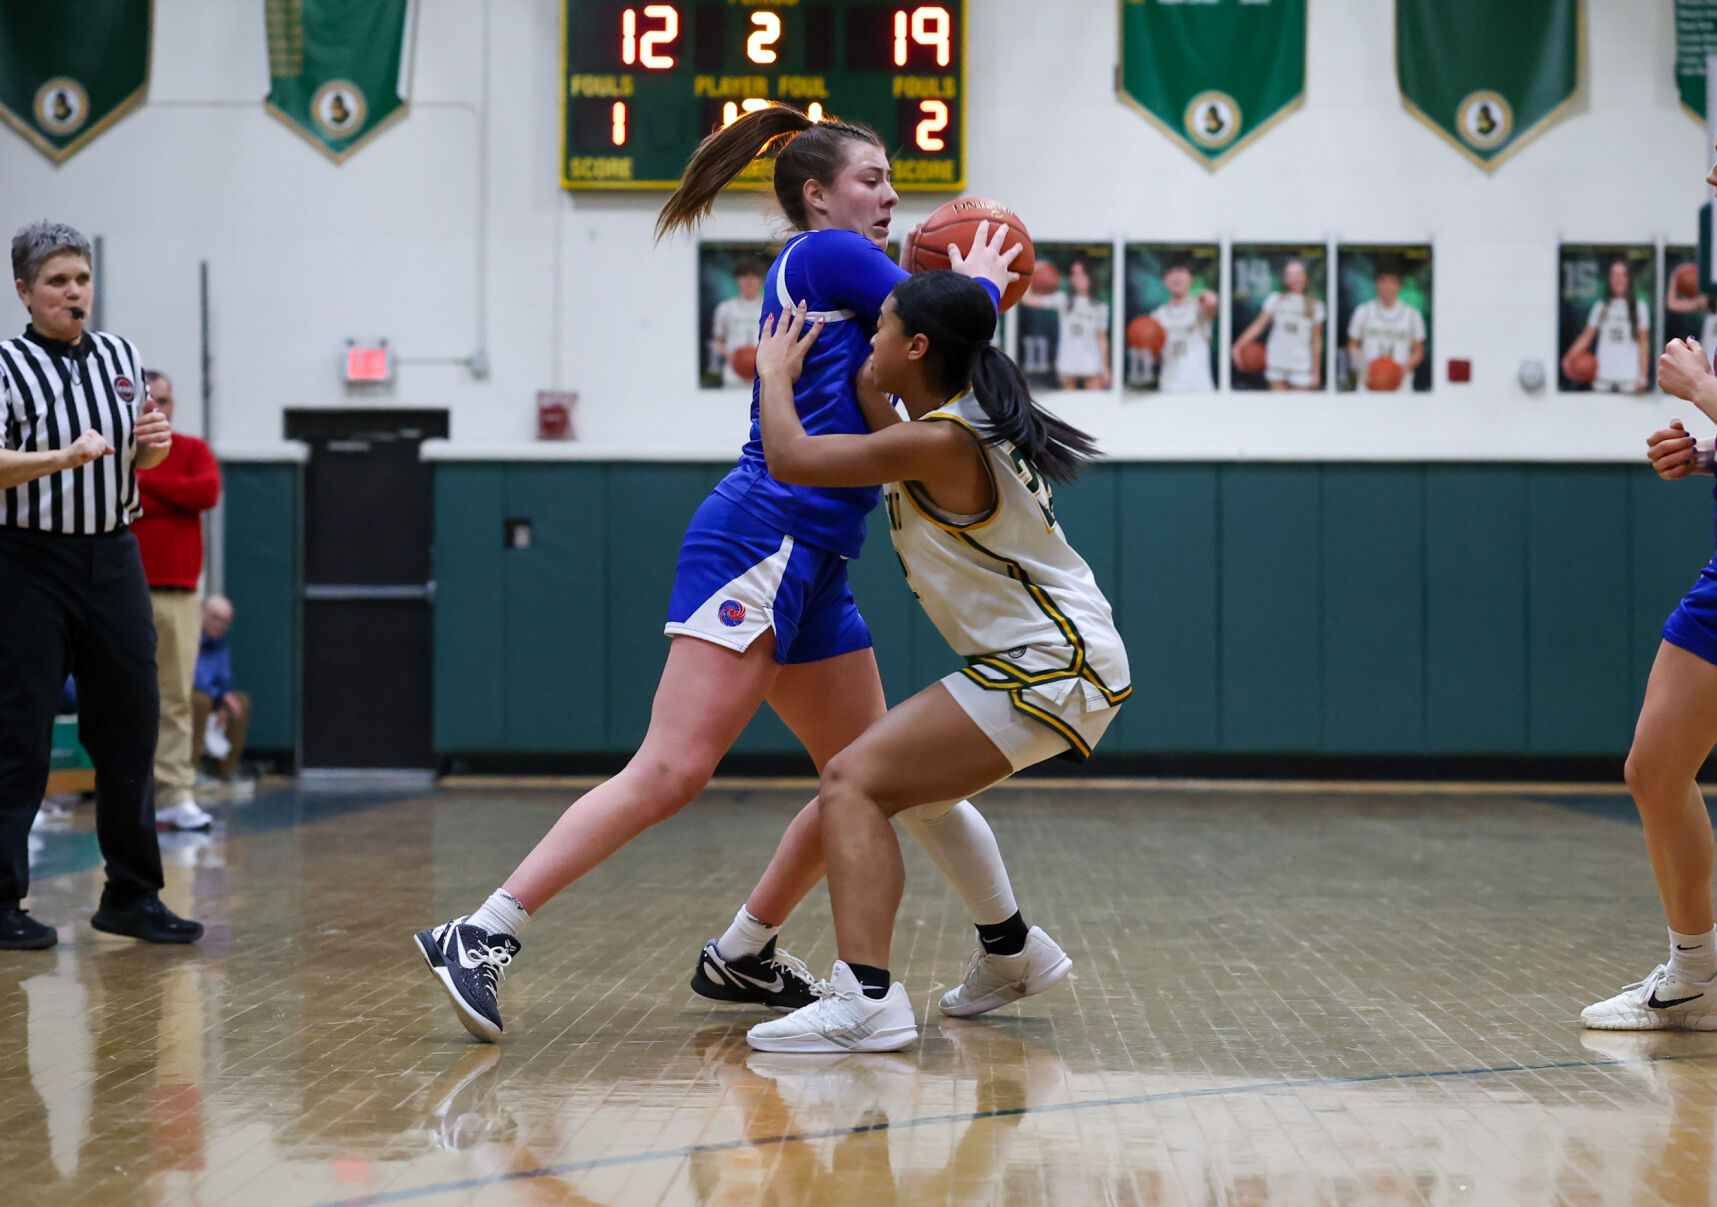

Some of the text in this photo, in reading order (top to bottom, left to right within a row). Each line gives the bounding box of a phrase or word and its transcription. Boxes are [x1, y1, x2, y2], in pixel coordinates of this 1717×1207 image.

[622, 5, 679, 69] 12
[747, 11, 781, 64] 2
[894, 6, 950, 67] 19
[570, 74, 635, 98] FOULS
[694, 74, 830, 98] PLAYER FOUL
[892, 75, 956, 99] FOULS
[612, 100, 626, 147] 1
[915, 99, 949, 150] 2
[570, 157, 633, 179] SCORE
[892, 159, 955, 181] SCORE
